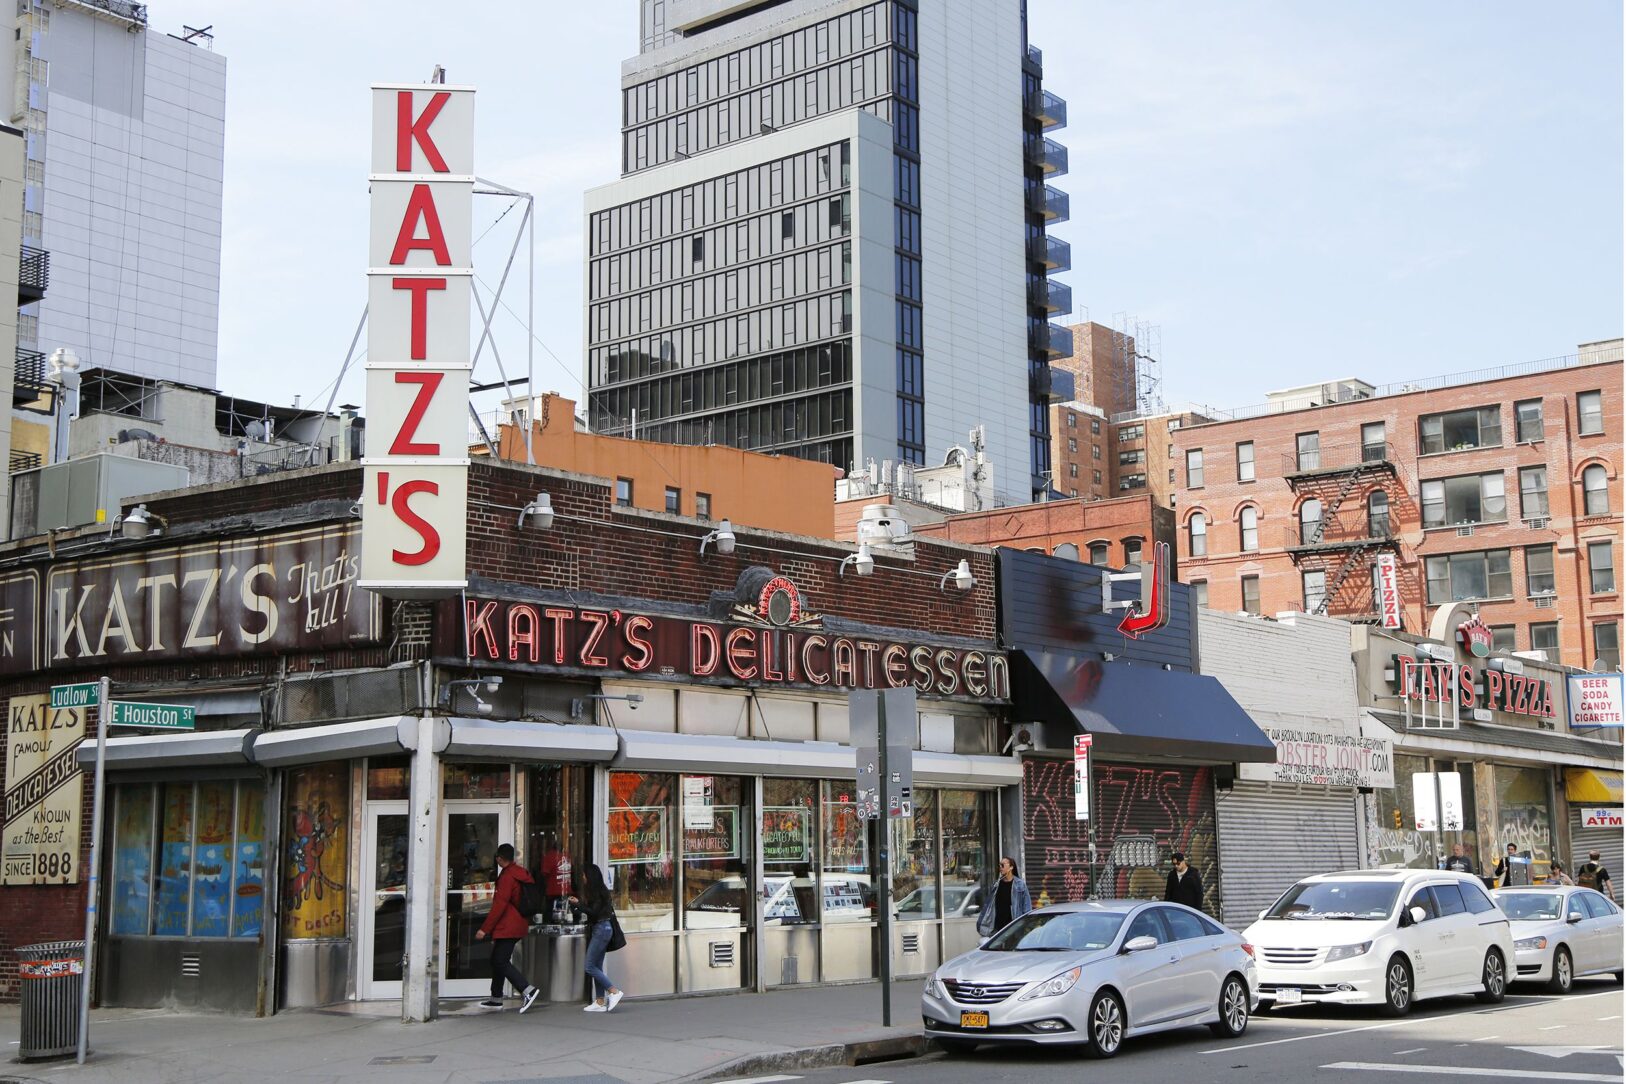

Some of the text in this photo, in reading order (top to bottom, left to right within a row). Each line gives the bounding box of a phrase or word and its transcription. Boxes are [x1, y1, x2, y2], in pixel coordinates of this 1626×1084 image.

[377, 91, 452, 567] KATZ'S
[287, 548, 359, 604] That's
[1381, 565, 1398, 628] PIZZA
[53, 562, 281, 661] KATZ'S
[305, 583, 352, 634] all!
[467, 599, 1011, 700] KATZ'S DELICATESSEN
[1583, 679, 1608, 688] BEER
[52, 687, 88, 707] Ludlow
[1486, 669, 1557, 718] PIZZA
[1583, 691, 1609, 700] SODA
[112, 704, 192, 725] E Houston St
[1581, 702, 1612, 711] CANDY
[1575, 713, 1620, 722] CIGARETTE
[1281, 729, 1303, 742] BROOKLYN
[1303, 731, 1322, 744] LOCATION
[1274, 771, 1292, 782] THANK
[33, 810, 71, 824] KNOWN
[1586, 816, 1623, 826] ATM
[13, 826, 64, 845] as the Best
[5, 861, 31, 877] SINCE
